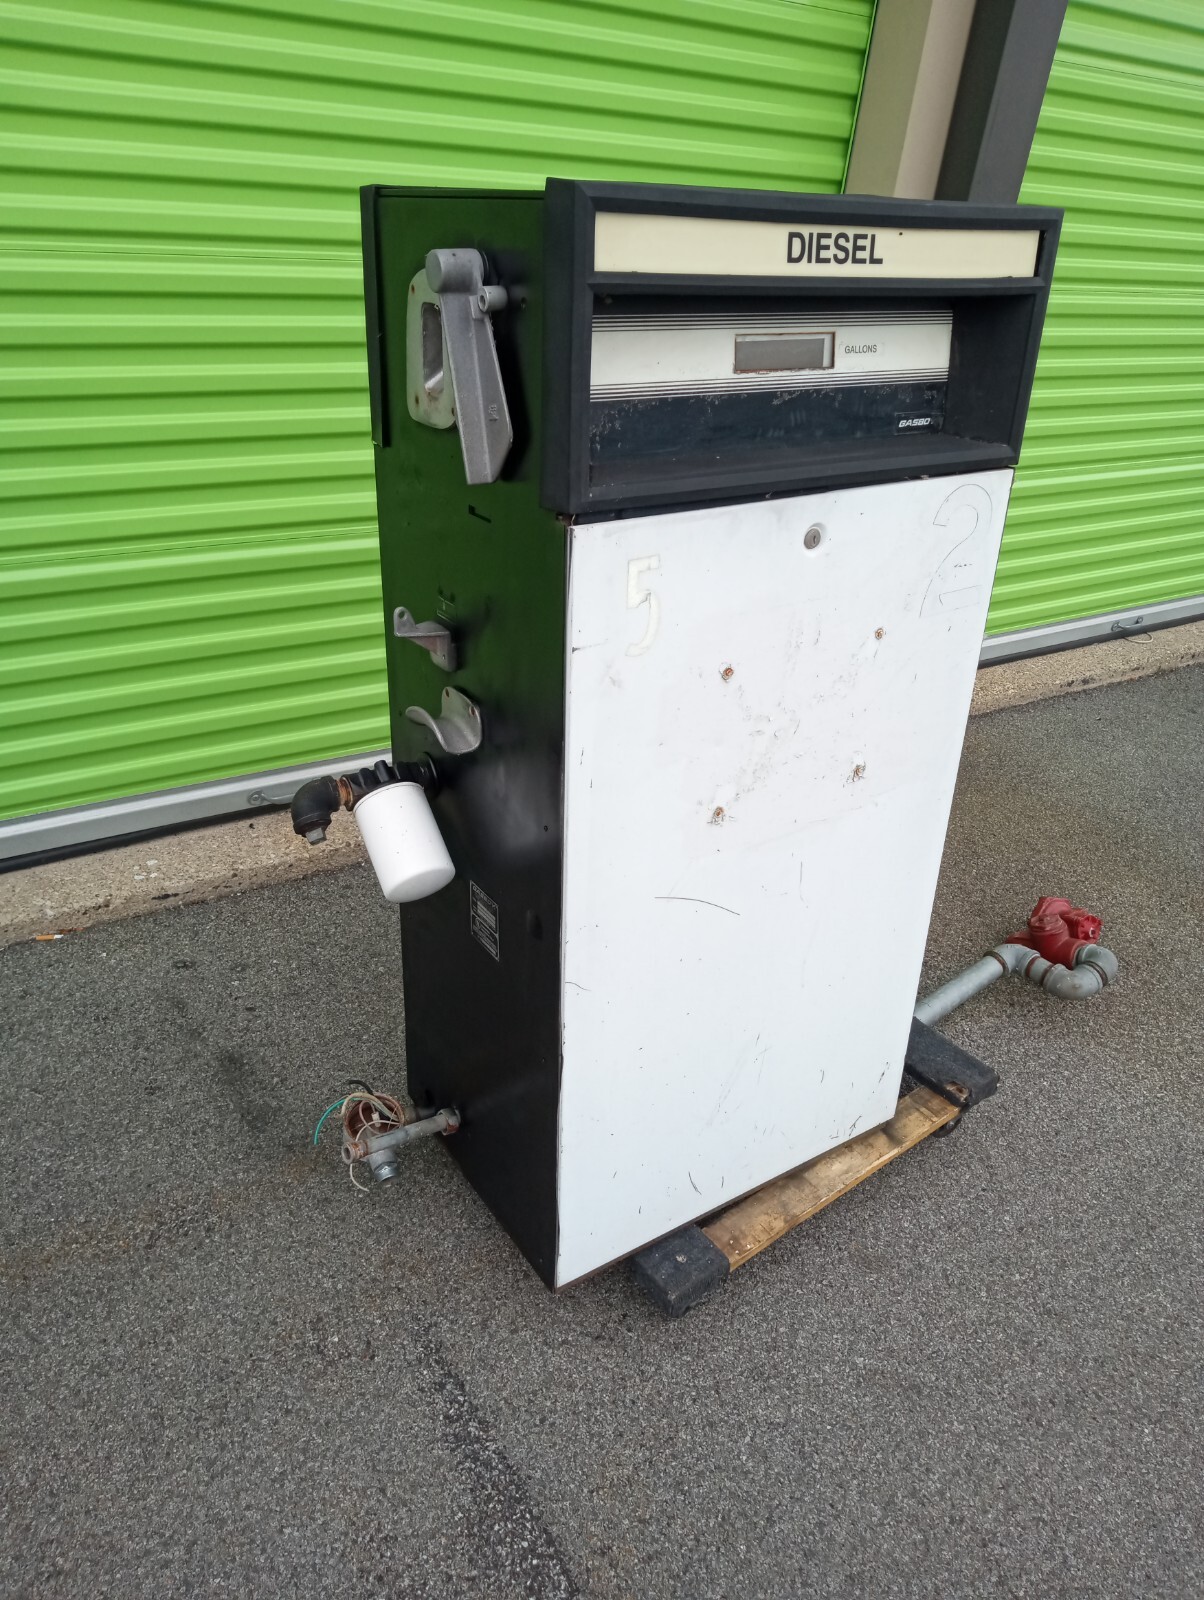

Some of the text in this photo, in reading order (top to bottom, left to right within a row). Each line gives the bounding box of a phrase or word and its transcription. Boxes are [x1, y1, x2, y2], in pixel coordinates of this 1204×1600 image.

[787, 231, 883, 265] DIESEL
[844, 344, 878, 354] GALLONS
[625, 554, 661, 658] 5
